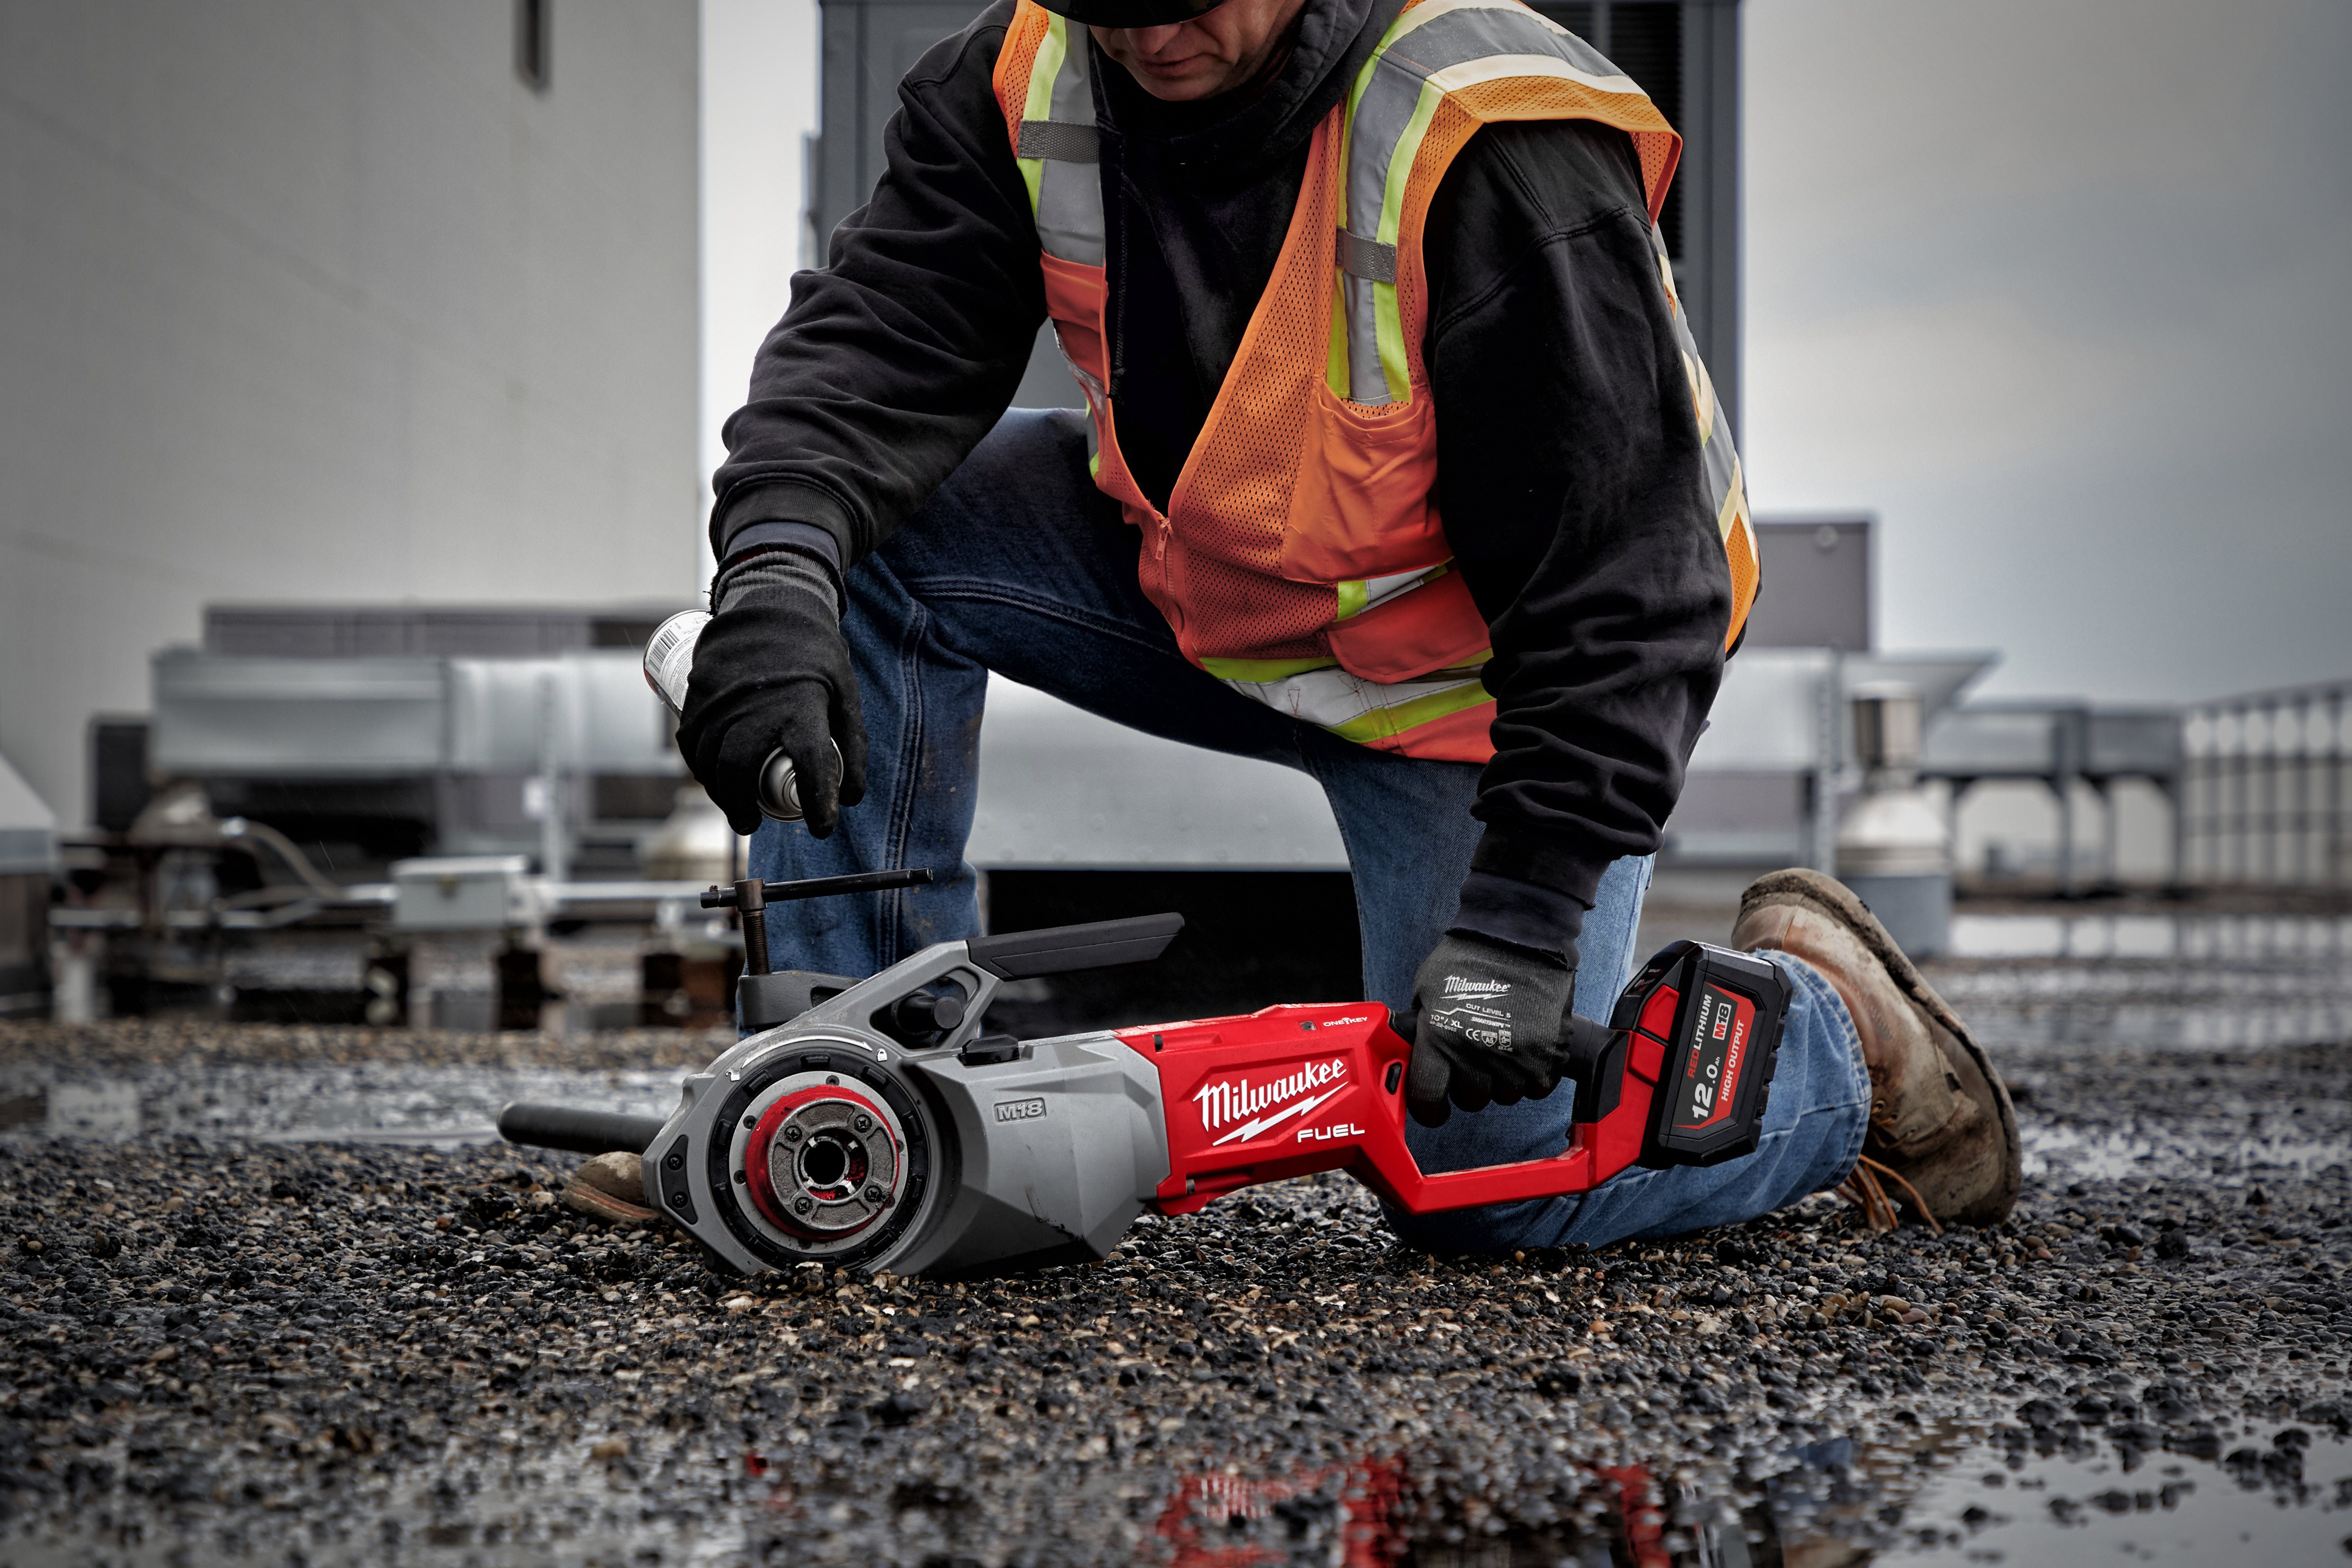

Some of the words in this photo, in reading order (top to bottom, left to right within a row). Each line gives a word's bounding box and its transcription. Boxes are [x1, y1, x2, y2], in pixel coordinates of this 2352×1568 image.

[1443, 975, 1509, 993] Milwaukee
[1482, 1007, 1504, 1016] LEVEL
[1713, 1004, 1730, 1039] M18
[1451, 1020, 1464, 1029] XL
[1687, 994, 1712, 1078] REDLITHIUM
[1721, 1068, 1734, 1101] HIGH
[1729, 1020, 1745, 1068] OUTPUT
[1193, 1059, 1347, 1132] Milwaukee
[997, 1101, 1043, 1121] M18
[1297, 1123, 1365, 1143] FUEL
